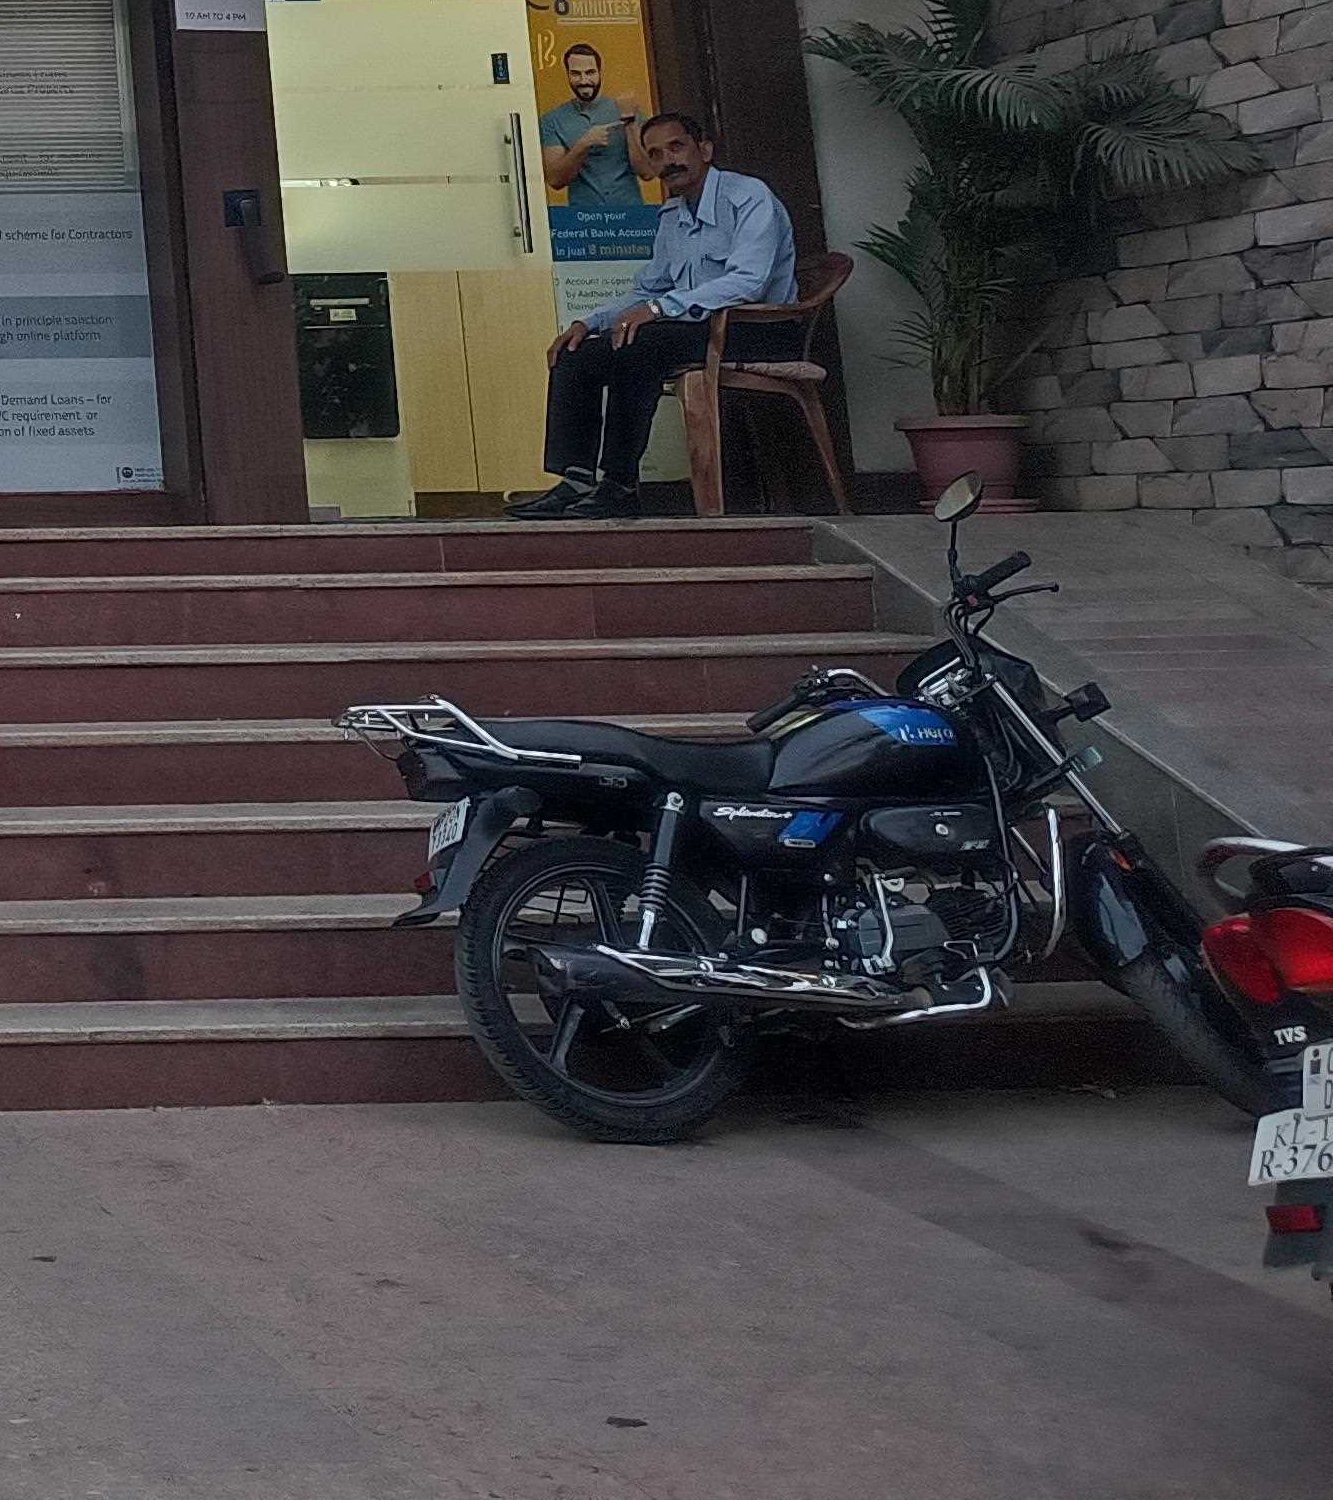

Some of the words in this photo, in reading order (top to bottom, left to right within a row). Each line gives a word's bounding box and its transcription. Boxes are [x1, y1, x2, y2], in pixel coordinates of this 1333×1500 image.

[576, 211, 602, 222] Open
[604, 211, 627, 225] your
[5, 229, 48, 241] scheme
[50, 228, 66, 240] for
[68, 228, 133, 240] Contractors
[551, 228, 589, 239] Federal
[590, 228, 616, 238] Bank
[599, 243, 652, 257] minutes
[15, 315, 63, 328] principle
[16, 330, 51, 341] online
[53, 330, 101, 343] platform
[50, 393, 84, 405] Loans
[96, 393, 112, 405] for
[11, 410, 81, 423] requirement
[85, 412, 98, 421] or
[14, 425, 25, 436] of
[28, 425, 56, 436] fixed
[58, 426, 95, 436] assets
[916, 727, 954, 741] Hero
[1274, 1026, 1307, 1045] TVS
